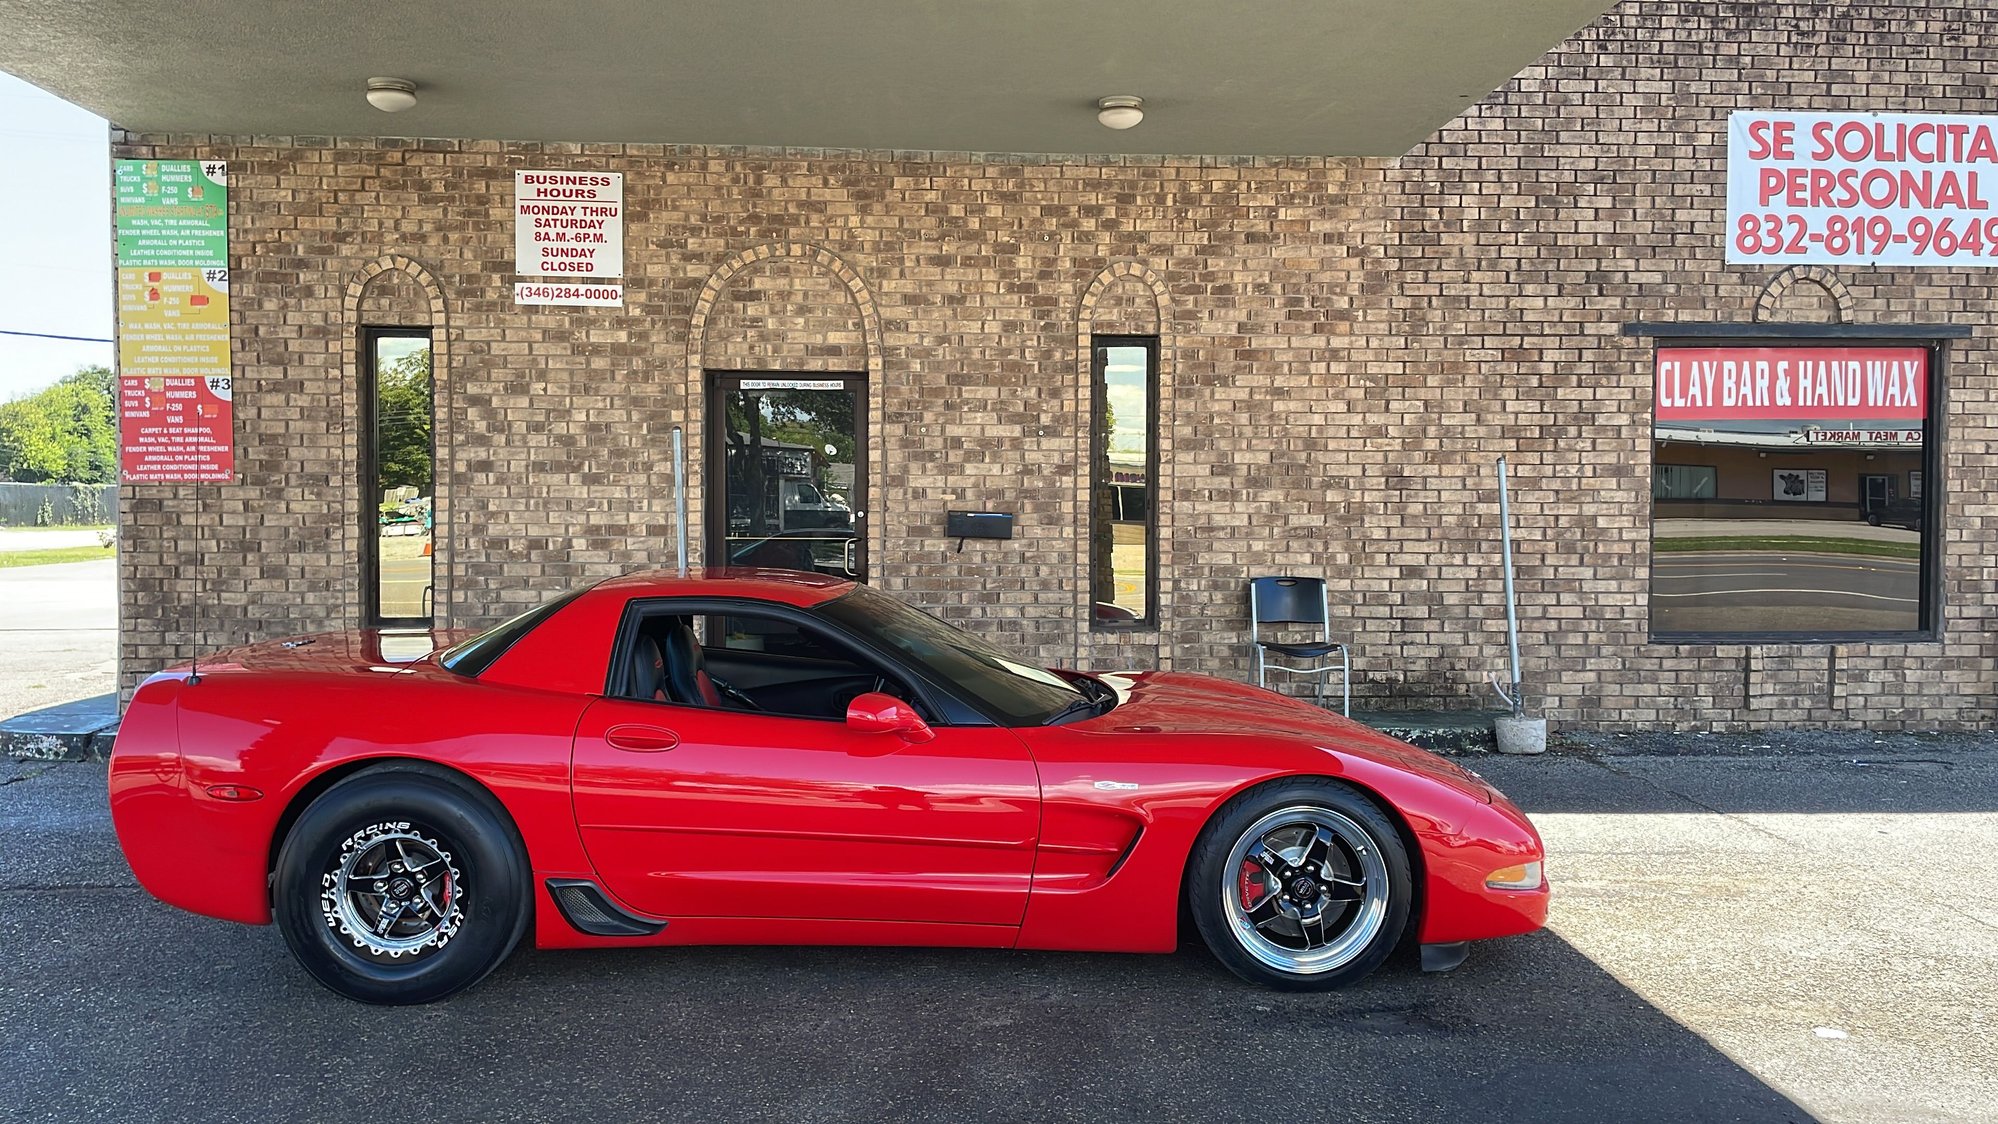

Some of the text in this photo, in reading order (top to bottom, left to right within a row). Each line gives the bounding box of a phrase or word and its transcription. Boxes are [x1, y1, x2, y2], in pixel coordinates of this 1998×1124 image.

[1748, 120, 1998, 164] SE SOLICITA
[161, 164, 191, 172] DUALLIES
[205, 164, 226, 176] #1
[524, 174, 611, 187] BUSINESS
[161, 186, 178, 194] F-250
[536, 188, 597, 199] HOURS
[1759, 167, 1989, 210] PERSONAL
[161, 197, 178, 205] VANS
[520, 205, 618, 217] MONDAY THRU
[534, 218, 605, 230] SATURDAY
[534, 232, 608, 243] 8A.M.-6P.M.
[541, 247, 596, 258] SUNDAY
[541, 261, 594, 273] CLOSED
[206, 269, 228, 282] #2
[520, 286, 618, 301] (346)284-0000
[165, 378, 195, 386] DUALLIES
[209, 377, 231, 390] #3
[1660, 361, 1919, 407] CLAY BAR & HAND WAX
[166, 391, 197, 399] HUMMERS
[166, 403, 183, 411] F-250
[166, 415, 184, 423] VANS
[321, 821, 411, 927] WELD RACING
[437, 912, 464, 949] USA
